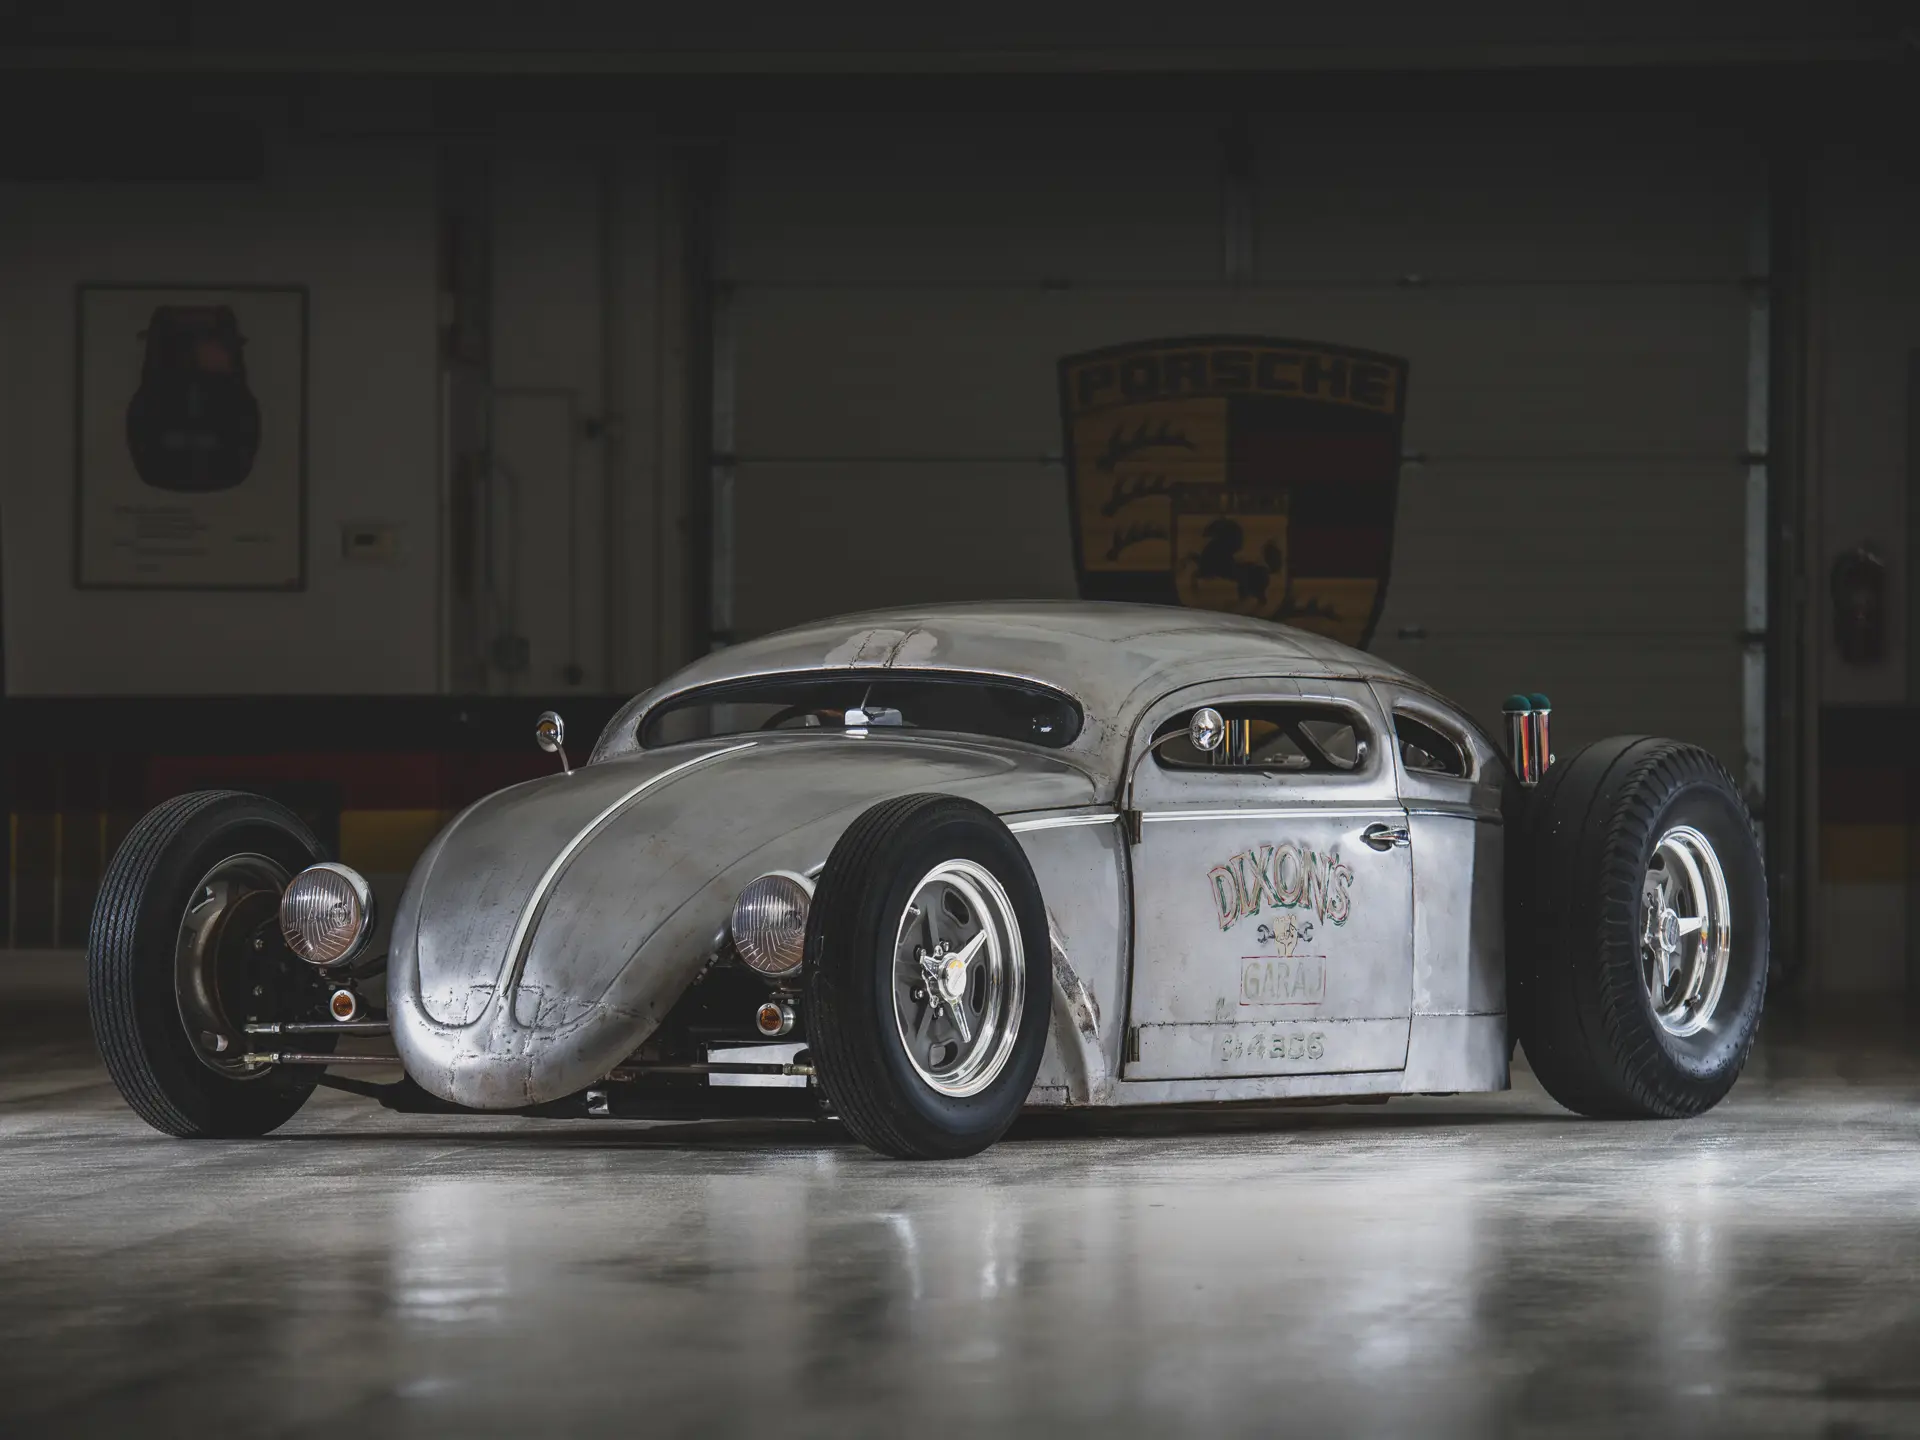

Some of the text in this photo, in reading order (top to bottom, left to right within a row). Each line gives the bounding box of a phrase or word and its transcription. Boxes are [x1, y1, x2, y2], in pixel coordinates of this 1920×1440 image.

[1077, 350, 1390, 406] PORSCHE
[1207, 844, 1354, 931] DIXON'S
[1243, 962, 1323, 1001] GARAJ
